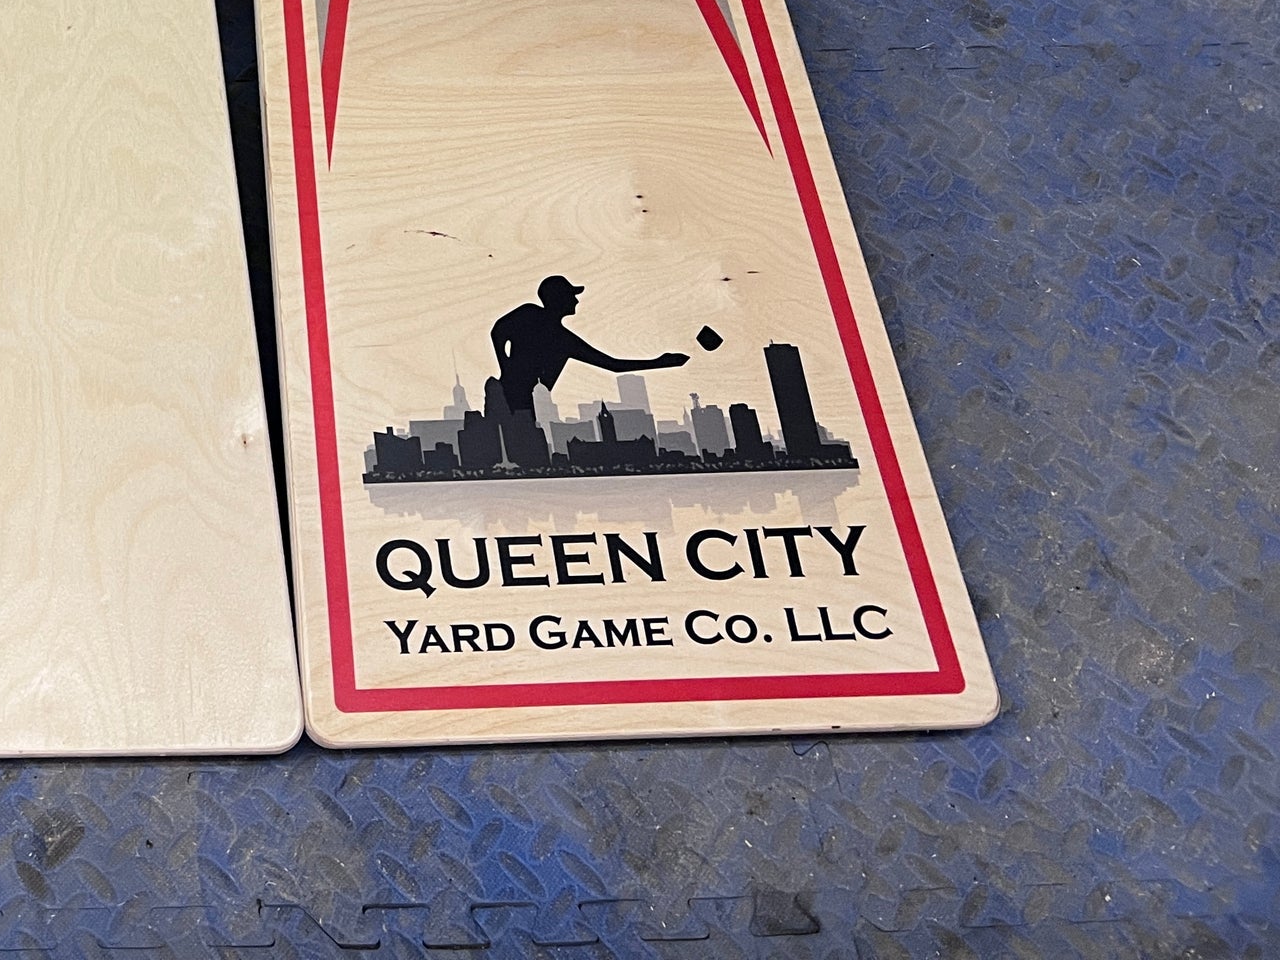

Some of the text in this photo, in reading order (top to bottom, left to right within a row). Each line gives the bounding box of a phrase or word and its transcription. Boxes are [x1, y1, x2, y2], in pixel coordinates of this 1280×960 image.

[375, 525, 867, 598] QUEEN CITY
[383, 619, 515, 655] YARD
[528, 614, 674, 649] GAME
[783, 604, 894, 642] LLC
